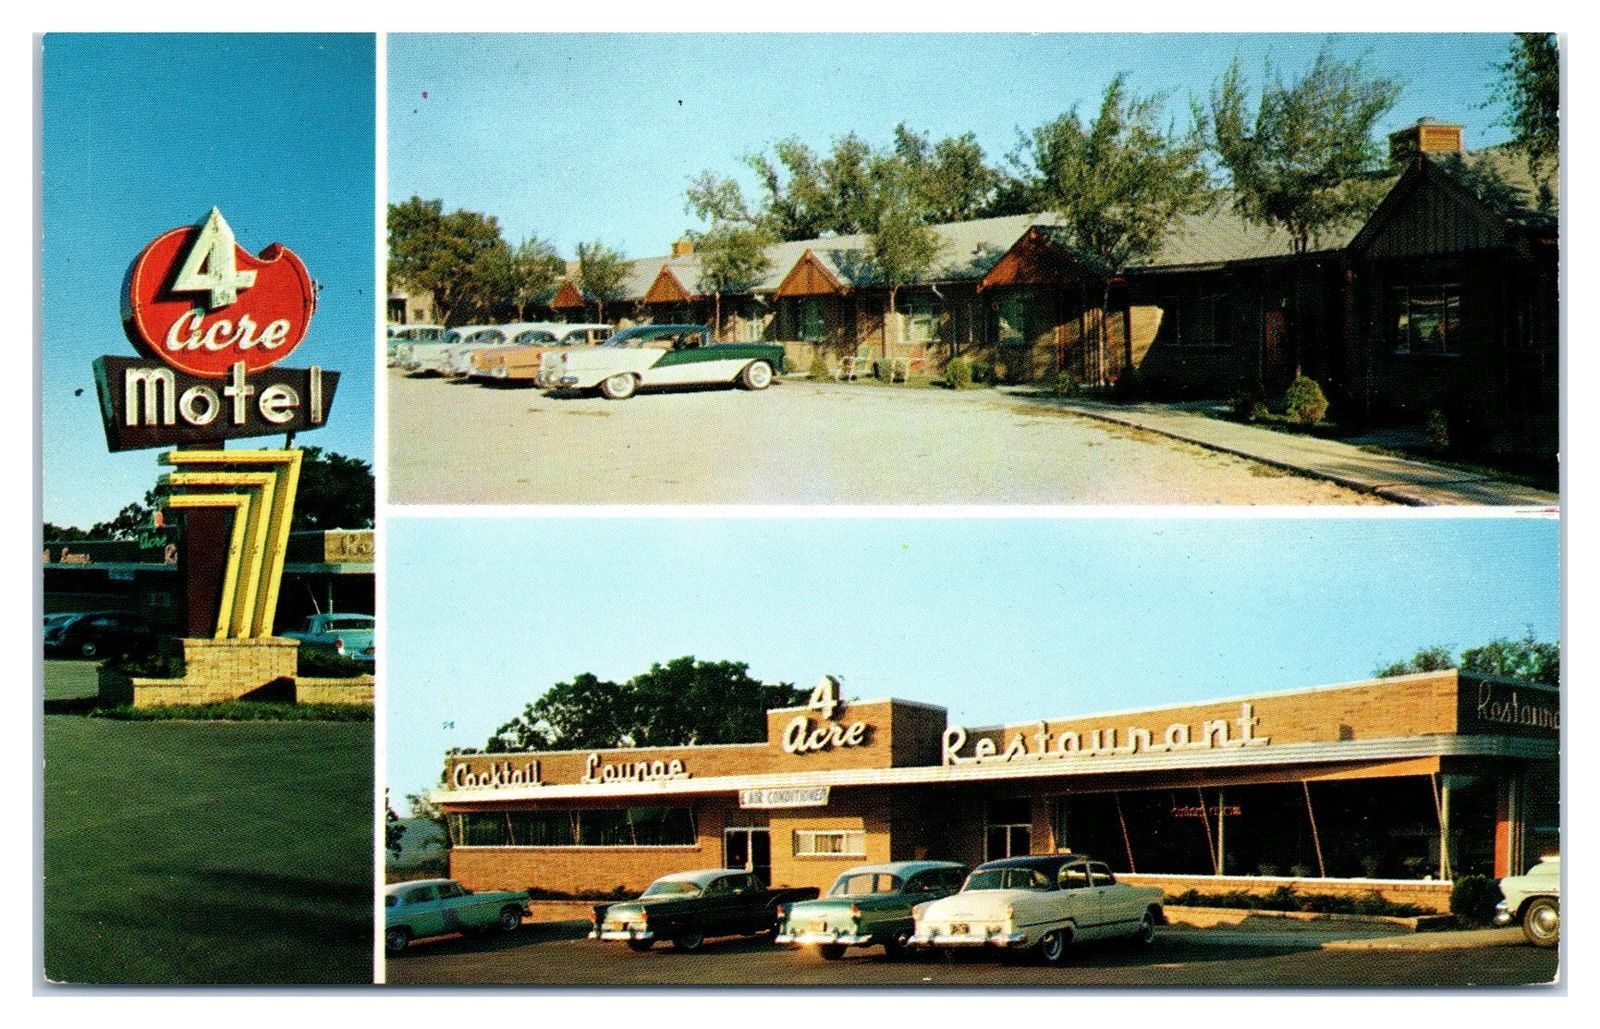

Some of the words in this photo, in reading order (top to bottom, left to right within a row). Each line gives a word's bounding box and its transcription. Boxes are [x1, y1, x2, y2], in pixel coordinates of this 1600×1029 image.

[172, 205, 258, 309] 4
[125, 360, 322, 427] Motel
[809, 676, 841, 719] 4
[782, 715, 868, 754] Acre
[942, 702, 1271, 767] Restaurant
[452, 760, 545, 789] Cocktail
[583, 752, 692, 785] Lounge
